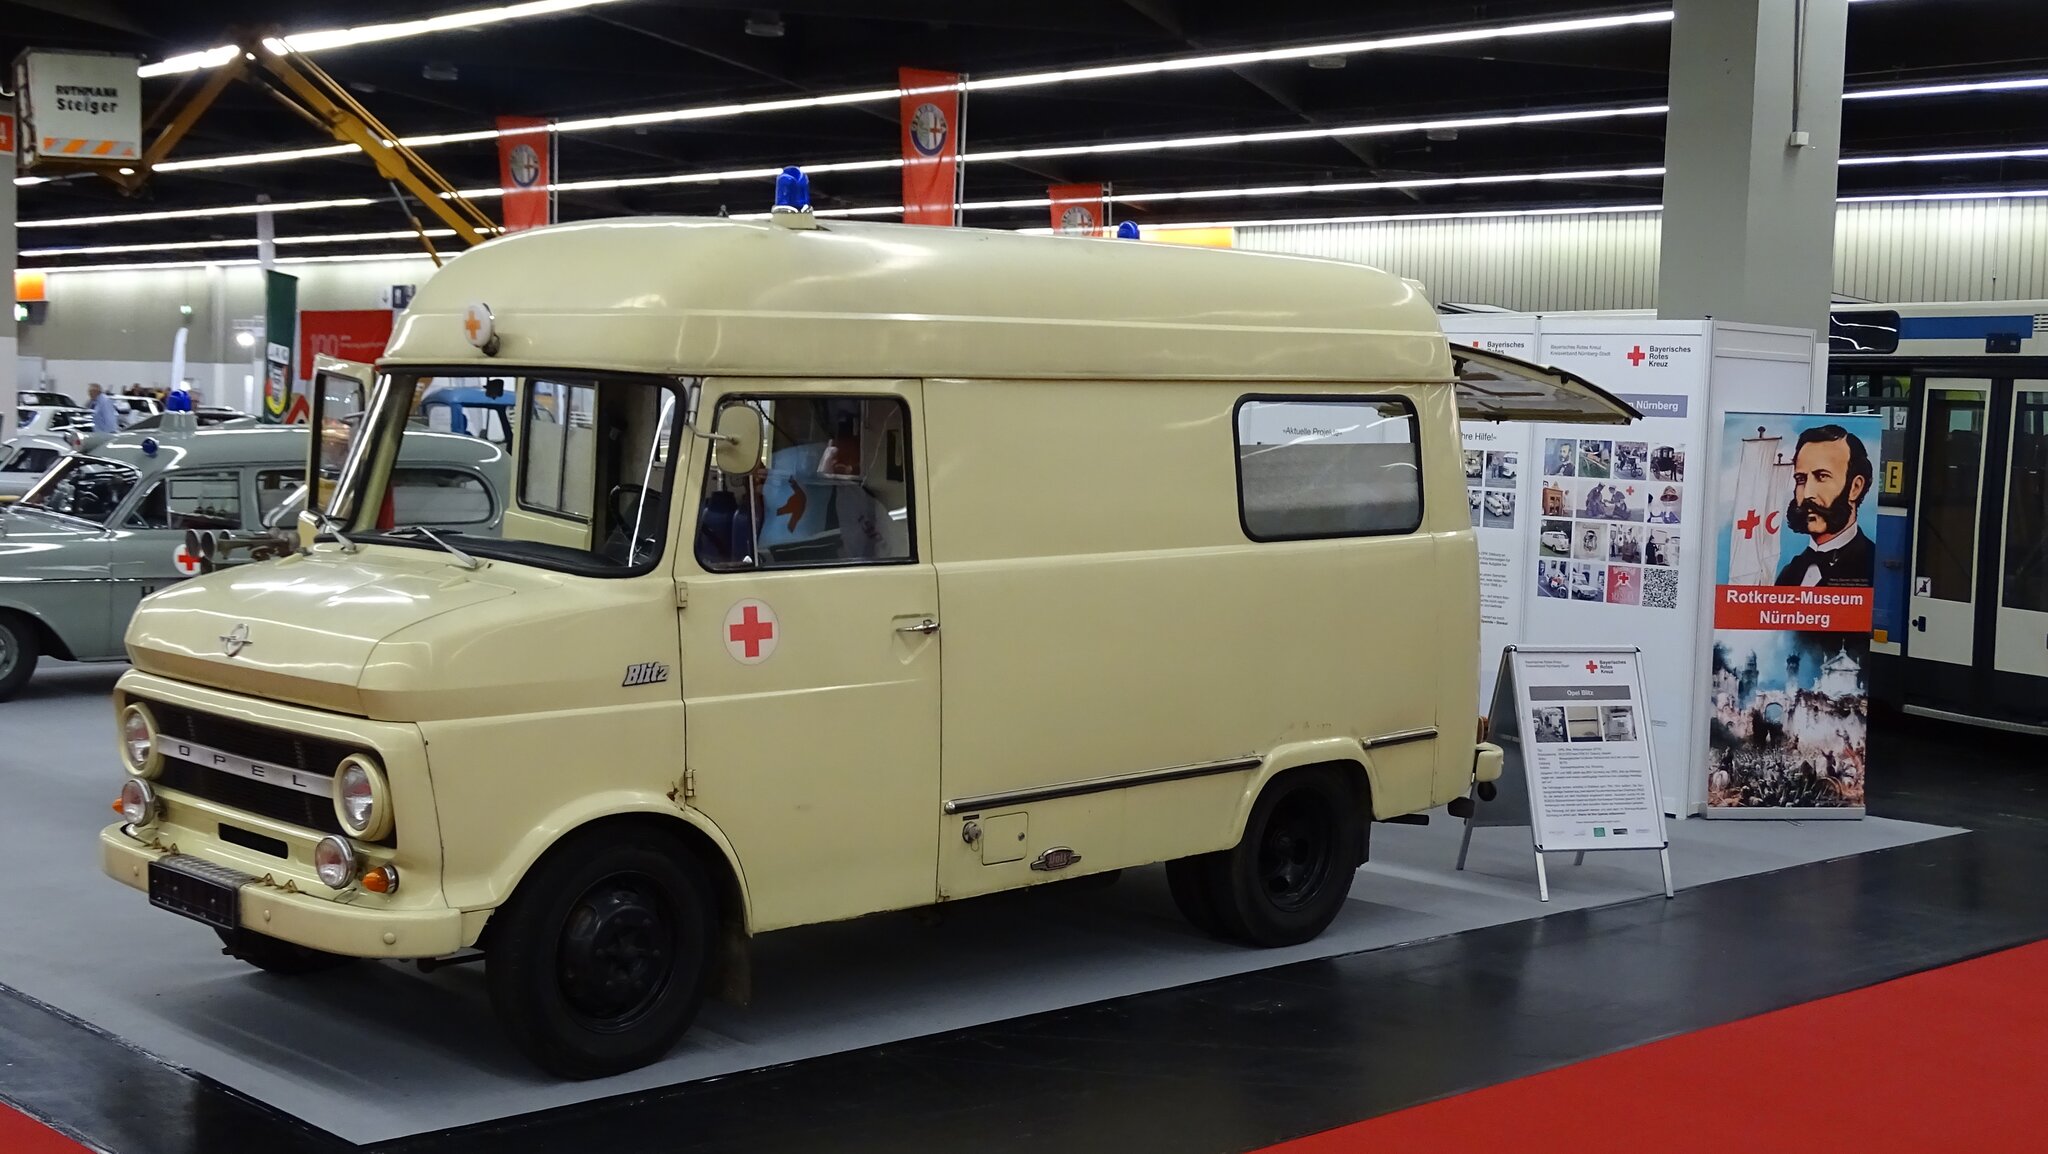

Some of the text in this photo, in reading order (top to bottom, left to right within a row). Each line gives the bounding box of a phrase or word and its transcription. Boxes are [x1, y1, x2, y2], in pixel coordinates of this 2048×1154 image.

[57, 99, 118, 114] Steiger
[1487, 341, 1524, 350] Bayerisches
[1649, 345, 1691, 354] Bayerisches
[1648, 360, 1669, 368] Kreuz
[1636, 400, 1679, 412] Nürnberg
[1889, 465, 1898, 489] E
[1727, 590, 1863, 605] Rotkreuz-Museum
[1759, 610, 1830, 628] Nürnberg
[623, 662, 669, 687] Blitz
[1566, 688, 1594, 697] Opel Blitz
[178, 744, 307, 788] OPEL
